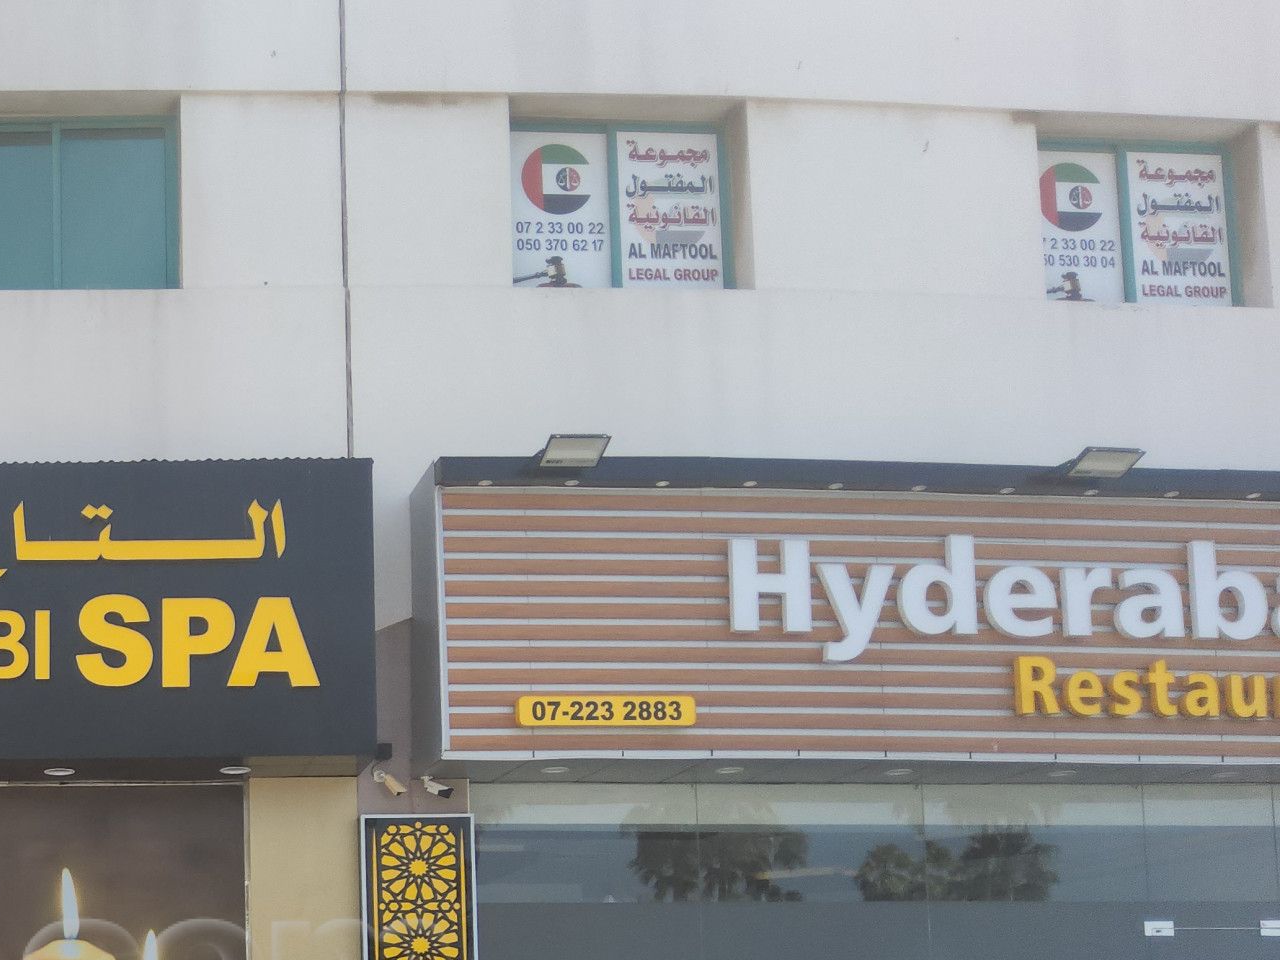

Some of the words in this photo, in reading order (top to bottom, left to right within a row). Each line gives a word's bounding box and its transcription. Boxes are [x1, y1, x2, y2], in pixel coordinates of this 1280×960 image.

[626, 140, 710, 167] مجموعة
[1136, 159, 1216, 188] مجموعة
[625, 173, 714, 198] المفتول
[1136, 193, 1221, 216] المفتول
[626, 203, 717, 231] القانونية
[516, 222, 531, 234] 07
[536, 222, 544, 234] 2
[548, 222, 563, 234] 33
[567, 222, 584, 234] 00
[588, 223, 605, 235] 22
[1138, 221, 1224, 247] القانونية
[517, 239, 541, 251] 050
[545, 239, 568, 251] 370
[572, 239, 588, 251] 62
[592, 240, 604, 251] 17
[628, 243, 646, 258] AL
[651, 243, 718, 259] MAFTOOL
[1061, 238, 1077, 250] 33
[1080, 239, 1096, 251] 00
[1100, 240, 1116, 252] 22
[1059, 254, 1080, 267] 530
[1083, 255, 1097, 267] 30
[1100, 256, 1116, 268] 04
[1141, 260, 1158, 275] AL
[1162, 260, 1226, 277] MAFTOOL
[629, 269, 670, 280] LEGAL
[674, 269, 719, 281] GROUP
[1142, 285, 1182, 297] LEGAL
[1184, 286, 1227, 298] GROUP
[728, 534, 1280, 663] Hyderab
[76, 593, 321, 689] SPA
[1014, 655, 1280, 719] Restau
[532, 701, 615, 721] 07-223
[623, 701, 682, 720] 2883
